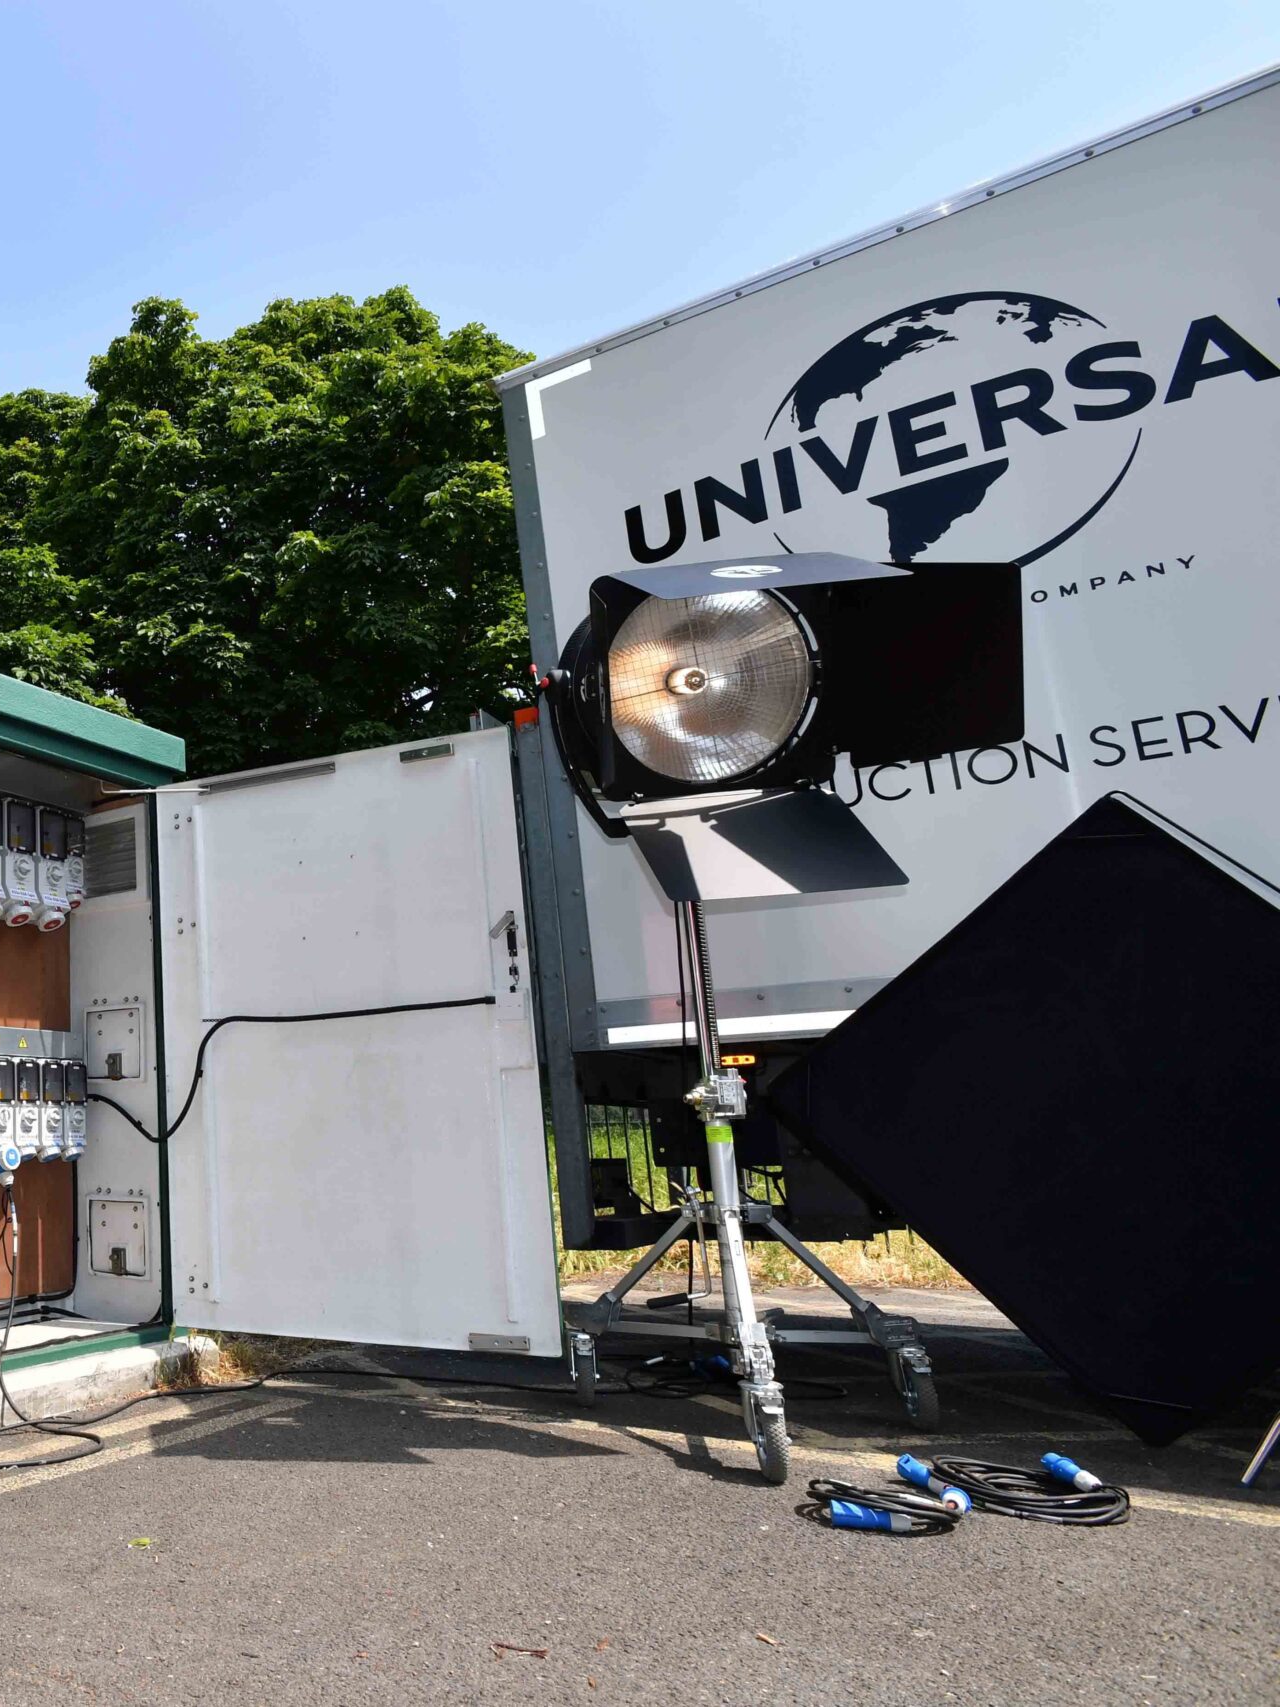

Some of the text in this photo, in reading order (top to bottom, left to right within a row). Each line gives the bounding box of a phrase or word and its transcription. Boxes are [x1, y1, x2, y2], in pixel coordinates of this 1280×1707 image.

[624, 297, 1280, 564] UNIVERSA
[1030, 554, 1195, 603] OMPANY
[829, 695, 1280, 807] UCTION SERV
